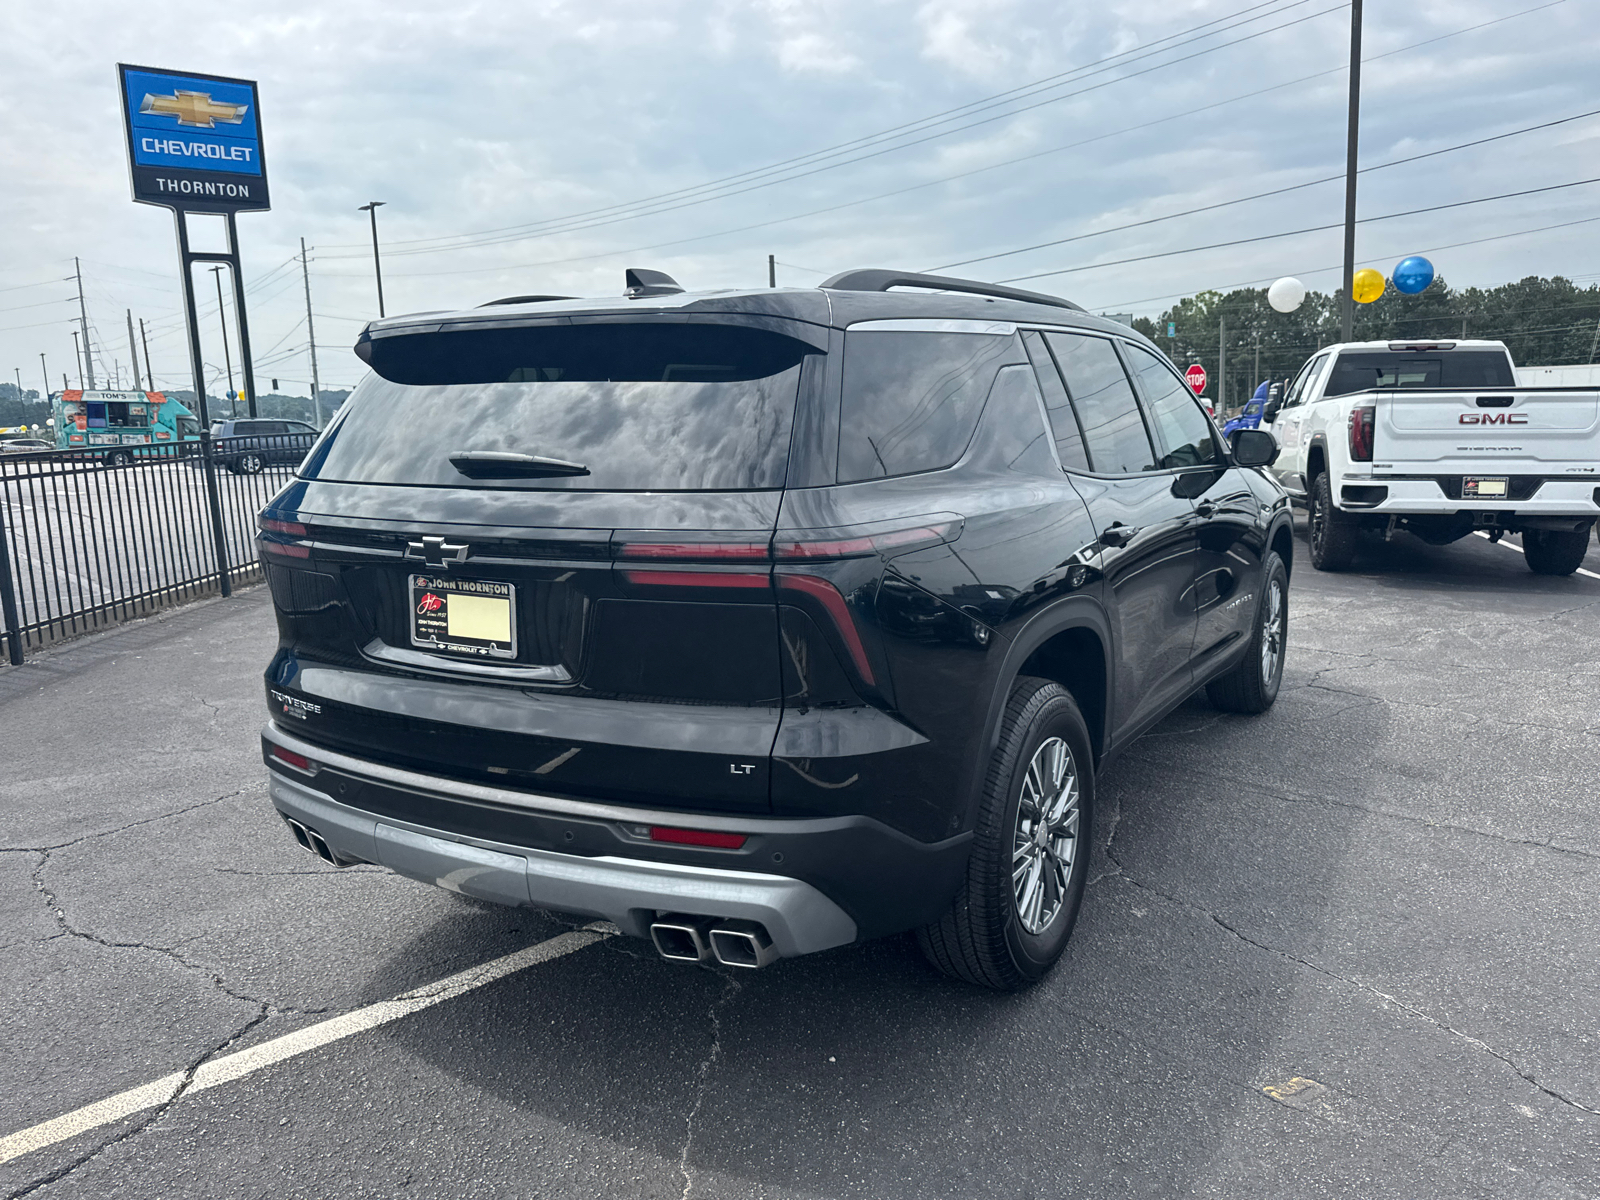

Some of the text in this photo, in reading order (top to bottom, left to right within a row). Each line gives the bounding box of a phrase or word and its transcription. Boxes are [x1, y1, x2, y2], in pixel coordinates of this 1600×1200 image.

[141, 137, 253, 162] CHEVROLET
[156, 178, 250, 198] THORNTON
[1186, 374, 1205, 386] STOP
[100, 392, 127, 400] TOM'S
[1458, 413, 1528, 425] GMC
[432, 578, 457, 590] JOHN
[457, 581, 509, 595] THORNTON
[447, 644, 478, 653] CHEVROLET
[730, 763, 756, 775] LT
